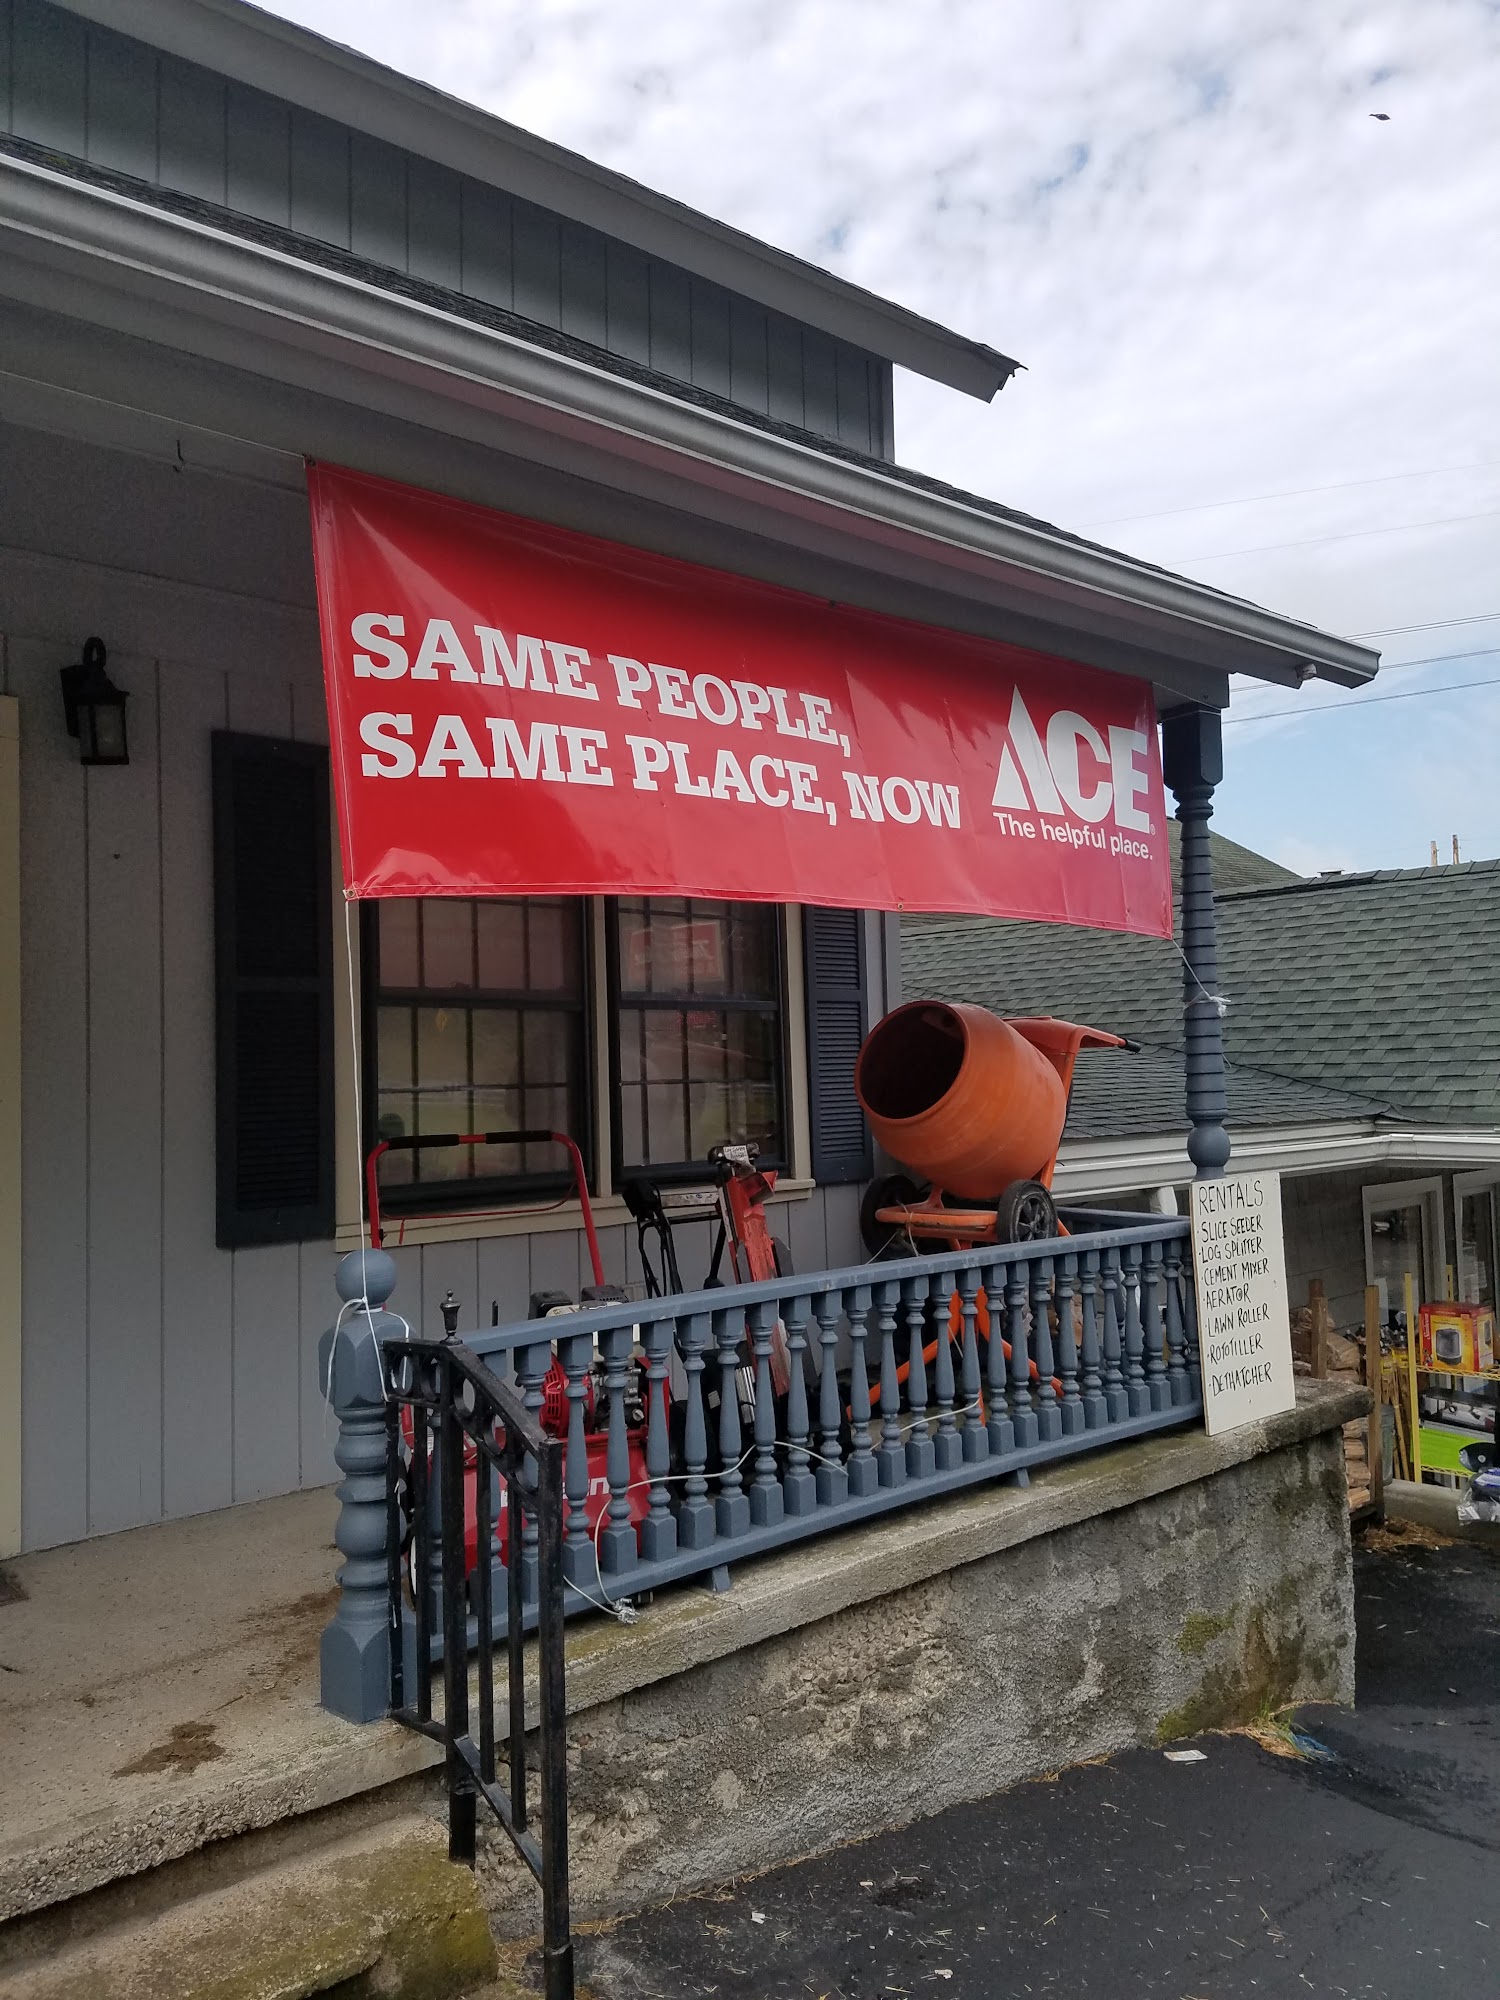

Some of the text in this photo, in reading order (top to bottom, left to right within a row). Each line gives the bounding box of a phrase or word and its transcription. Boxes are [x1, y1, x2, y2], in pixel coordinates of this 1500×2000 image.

[351, 612, 851, 758] SAME PEOPLE,
[359, 712, 961, 829] SAME PLACE, NOW
[991, 684, 1150, 834] ACE
[993, 812, 1153, 860] The helpful place.
[1198, 1180, 1264, 1215] RENTALS
[1201, 1214, 1264, 1243] SLICE SEEDER
[1201, 1236, 1265, 1264] LOG SPLITTER
[1203, 1257, 1270, 1287] CEMENT MIXER
[1206, 1282, 1252, 1312] AERATOR
[1207, 1302, 1270, 1338] LAWN ROLLER
[1209, 1332, 1264, 1365] ROTOTILLER
[1211, 1361, 1273, 1397] DETHATCHER
